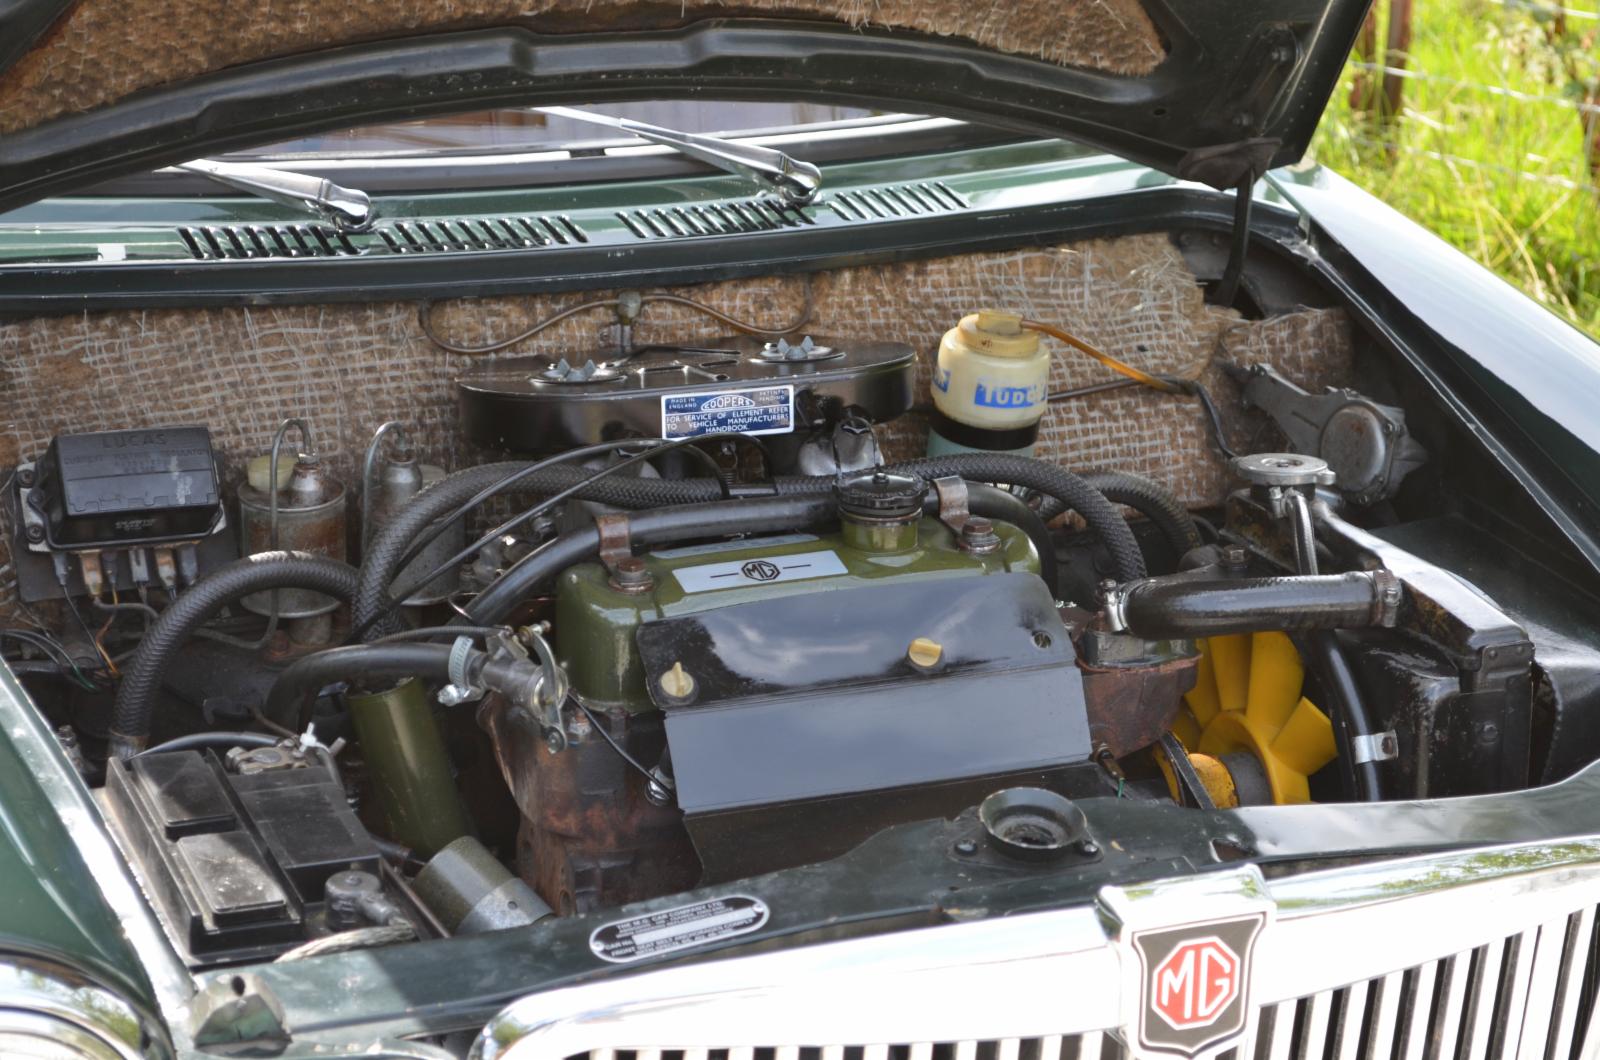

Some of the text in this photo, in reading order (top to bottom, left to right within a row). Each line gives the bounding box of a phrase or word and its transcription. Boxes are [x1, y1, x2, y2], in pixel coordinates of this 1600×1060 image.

[704, 396, 750, 409] COOPERS
[666, 415, 681, 423] FOR
[683, 413, 712, 422] SERVICE
[732, 408, 763, 417] ELEMENT
[768, 406, 788, 414] REFER
[688, 420, 718, 429] VEHICLE
[727, 414, 789, 425] MANUFACTURERS
[102, 433, 167, 448] LUCAS
[746, 563, 774, 578] MG
[1161, 946, 1231, 1019] MG
